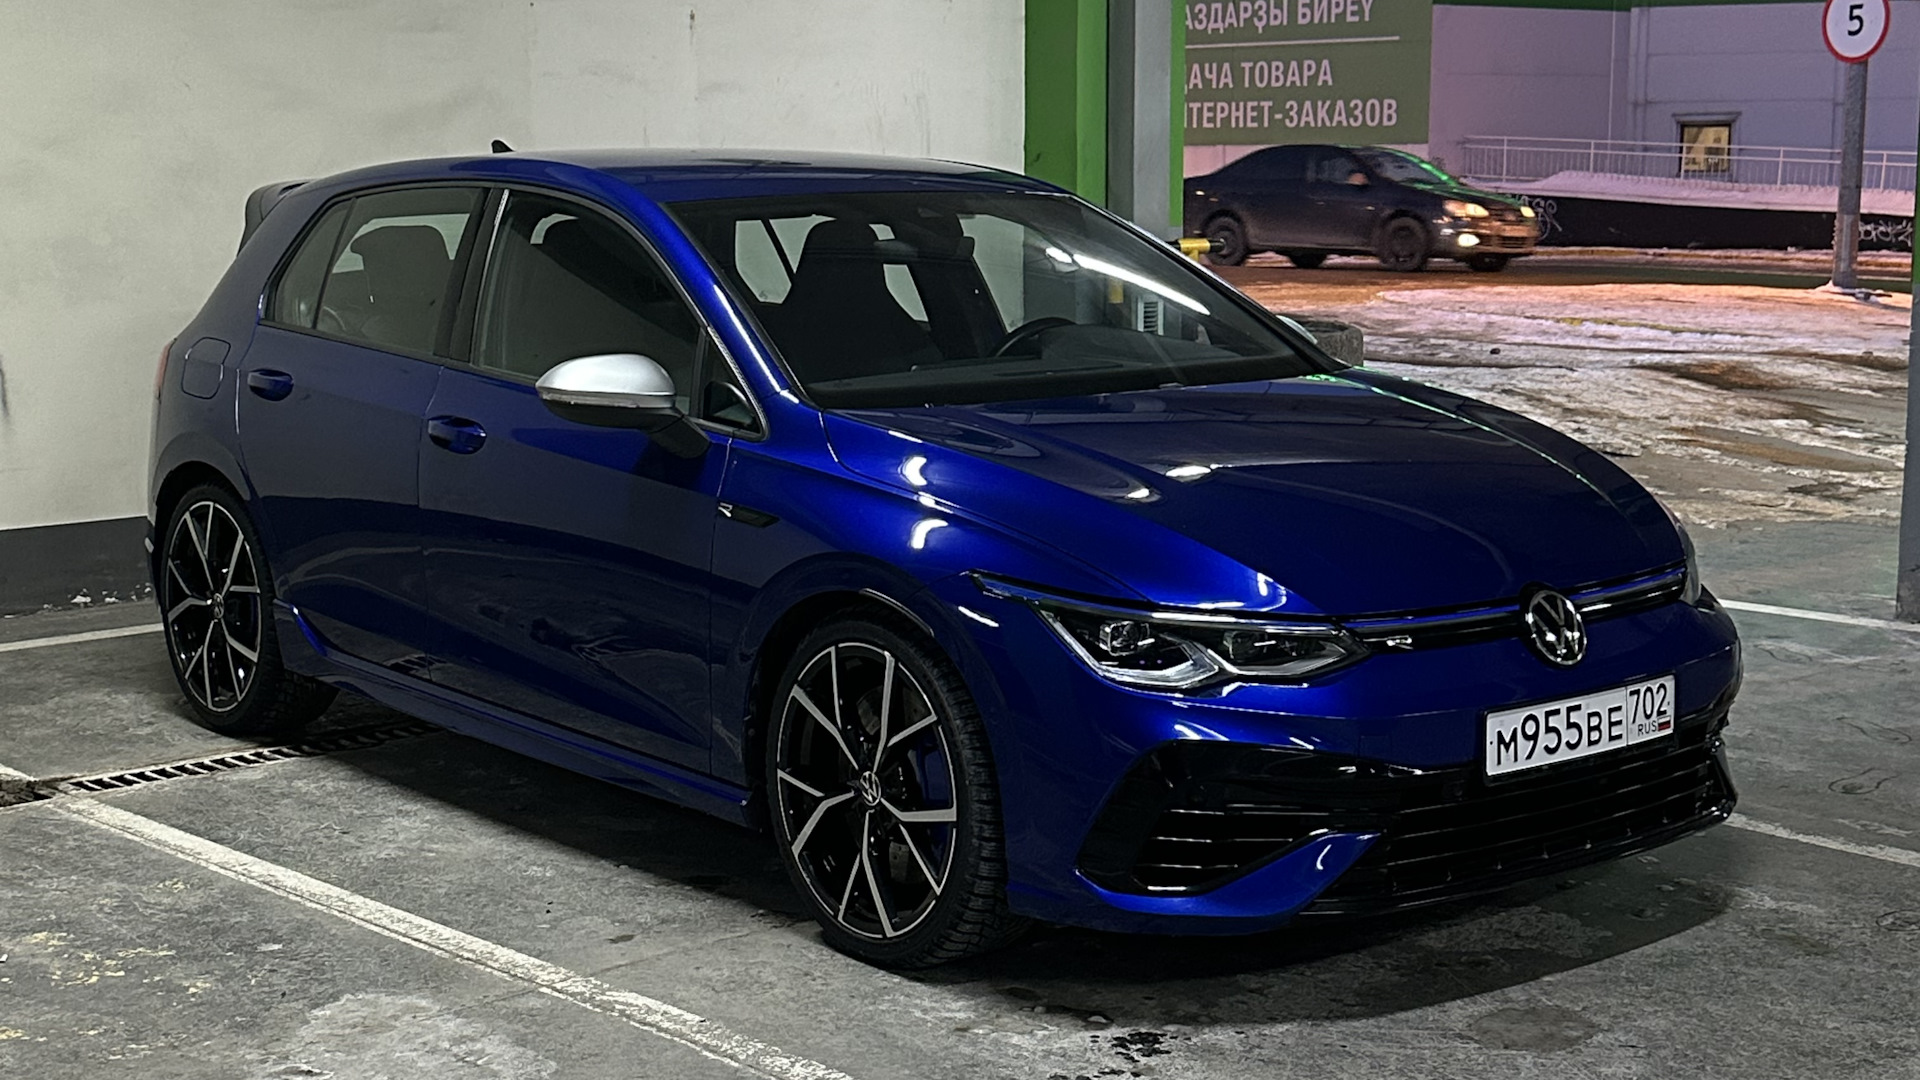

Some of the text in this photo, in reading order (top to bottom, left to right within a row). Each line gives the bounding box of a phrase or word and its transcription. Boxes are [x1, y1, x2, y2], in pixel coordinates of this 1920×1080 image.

[1847, 3, 1864, 36] 5
[1184, 59, 1333, 94] АЧА ТОВАРА
[1184, 98, 1398, 128] ТЕРНЕТ-ЗАКАЗОВ
[1496, 683, 1667, 766] М955ВЕ 702
[1637, 720, 1657, 736] RUS
